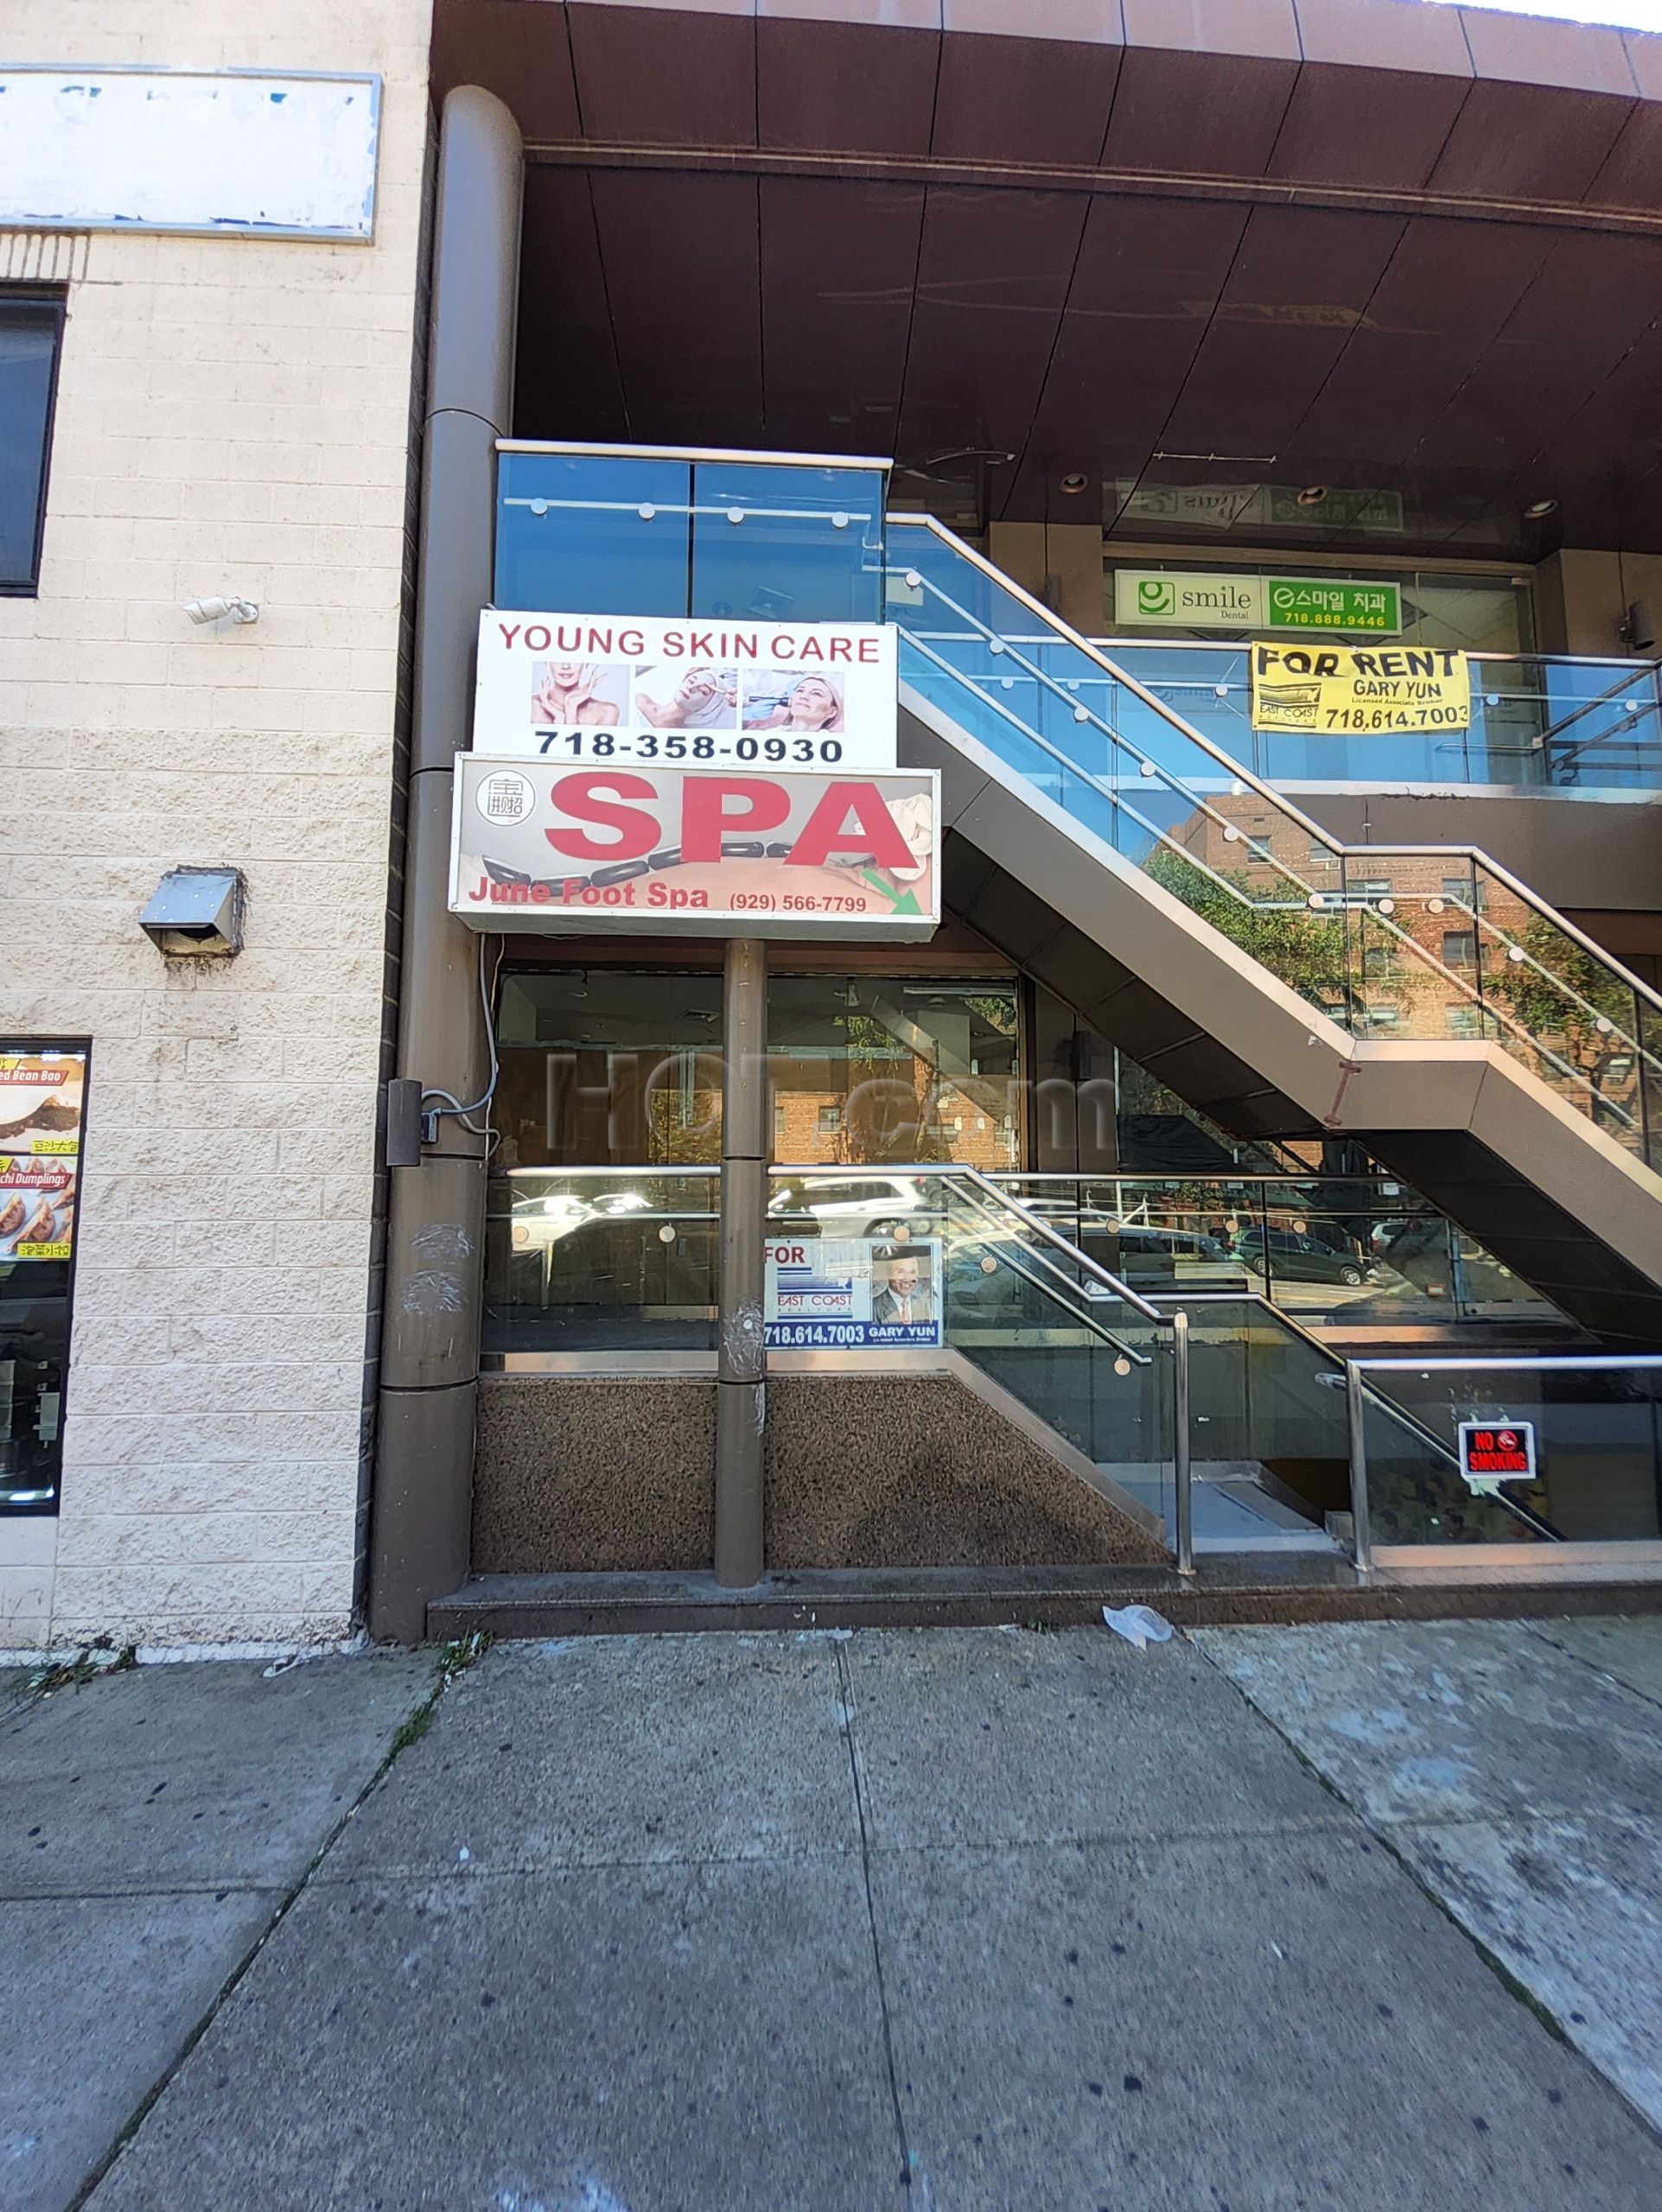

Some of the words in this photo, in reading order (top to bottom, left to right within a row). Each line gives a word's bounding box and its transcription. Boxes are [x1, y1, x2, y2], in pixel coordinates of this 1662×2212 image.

[1181, 586, 1251, 609] smile
[1353, 593, 1386, 613] 치과
[1220, 610, 1250, 620] Dental
[1284, 613, 1385, 626] 718.888.9446
[498, 623, 645, 656] YOUNG
[663, 632, 757, 658] SKIN
[771, 634, 880, 664] CARE
[1258, 646, 1347, 677] FOR
[1351, 650, 1459, 677] RENT
[1353, 679, 1400, 697] GARY
[1406, 681, 1442, 699] YUN
[1259, 704, 1279, 715] EAST
[1283, 707, 1318, 718] COAST
[1326, 705, 1468, 728] 718.614.7003
[534, 730, 844, 762] 718-358-0930
[544, 771, 920, 869] SPA
[468, 875, 551, 905] June
[563, 880, 636, 907] Foot
[646, 883, 710, 911] Spa
[729, 892, 777, 912] (929)
[782, 893, 867, 913] 566-7799
[13, 1070, 39, 1081] Bean
[41, 1070, 60, 1082] Bao
[16, 1173, 66, 1187] Dumplings
[764, 1246, 806, 1264] FOR
[778, 1296, 804, 1306] EAST
[812, 1296, 852, 1306] COAST
[764, 1325, 864, 1344] 718.614.7003
[869, 1326, 904, 1338] GARY
[907, 1326, 935, 1337] YUN
[1474, 1431, 1493, 1451] NO
[1469, 1452, 1526, 1471] SMOKING
